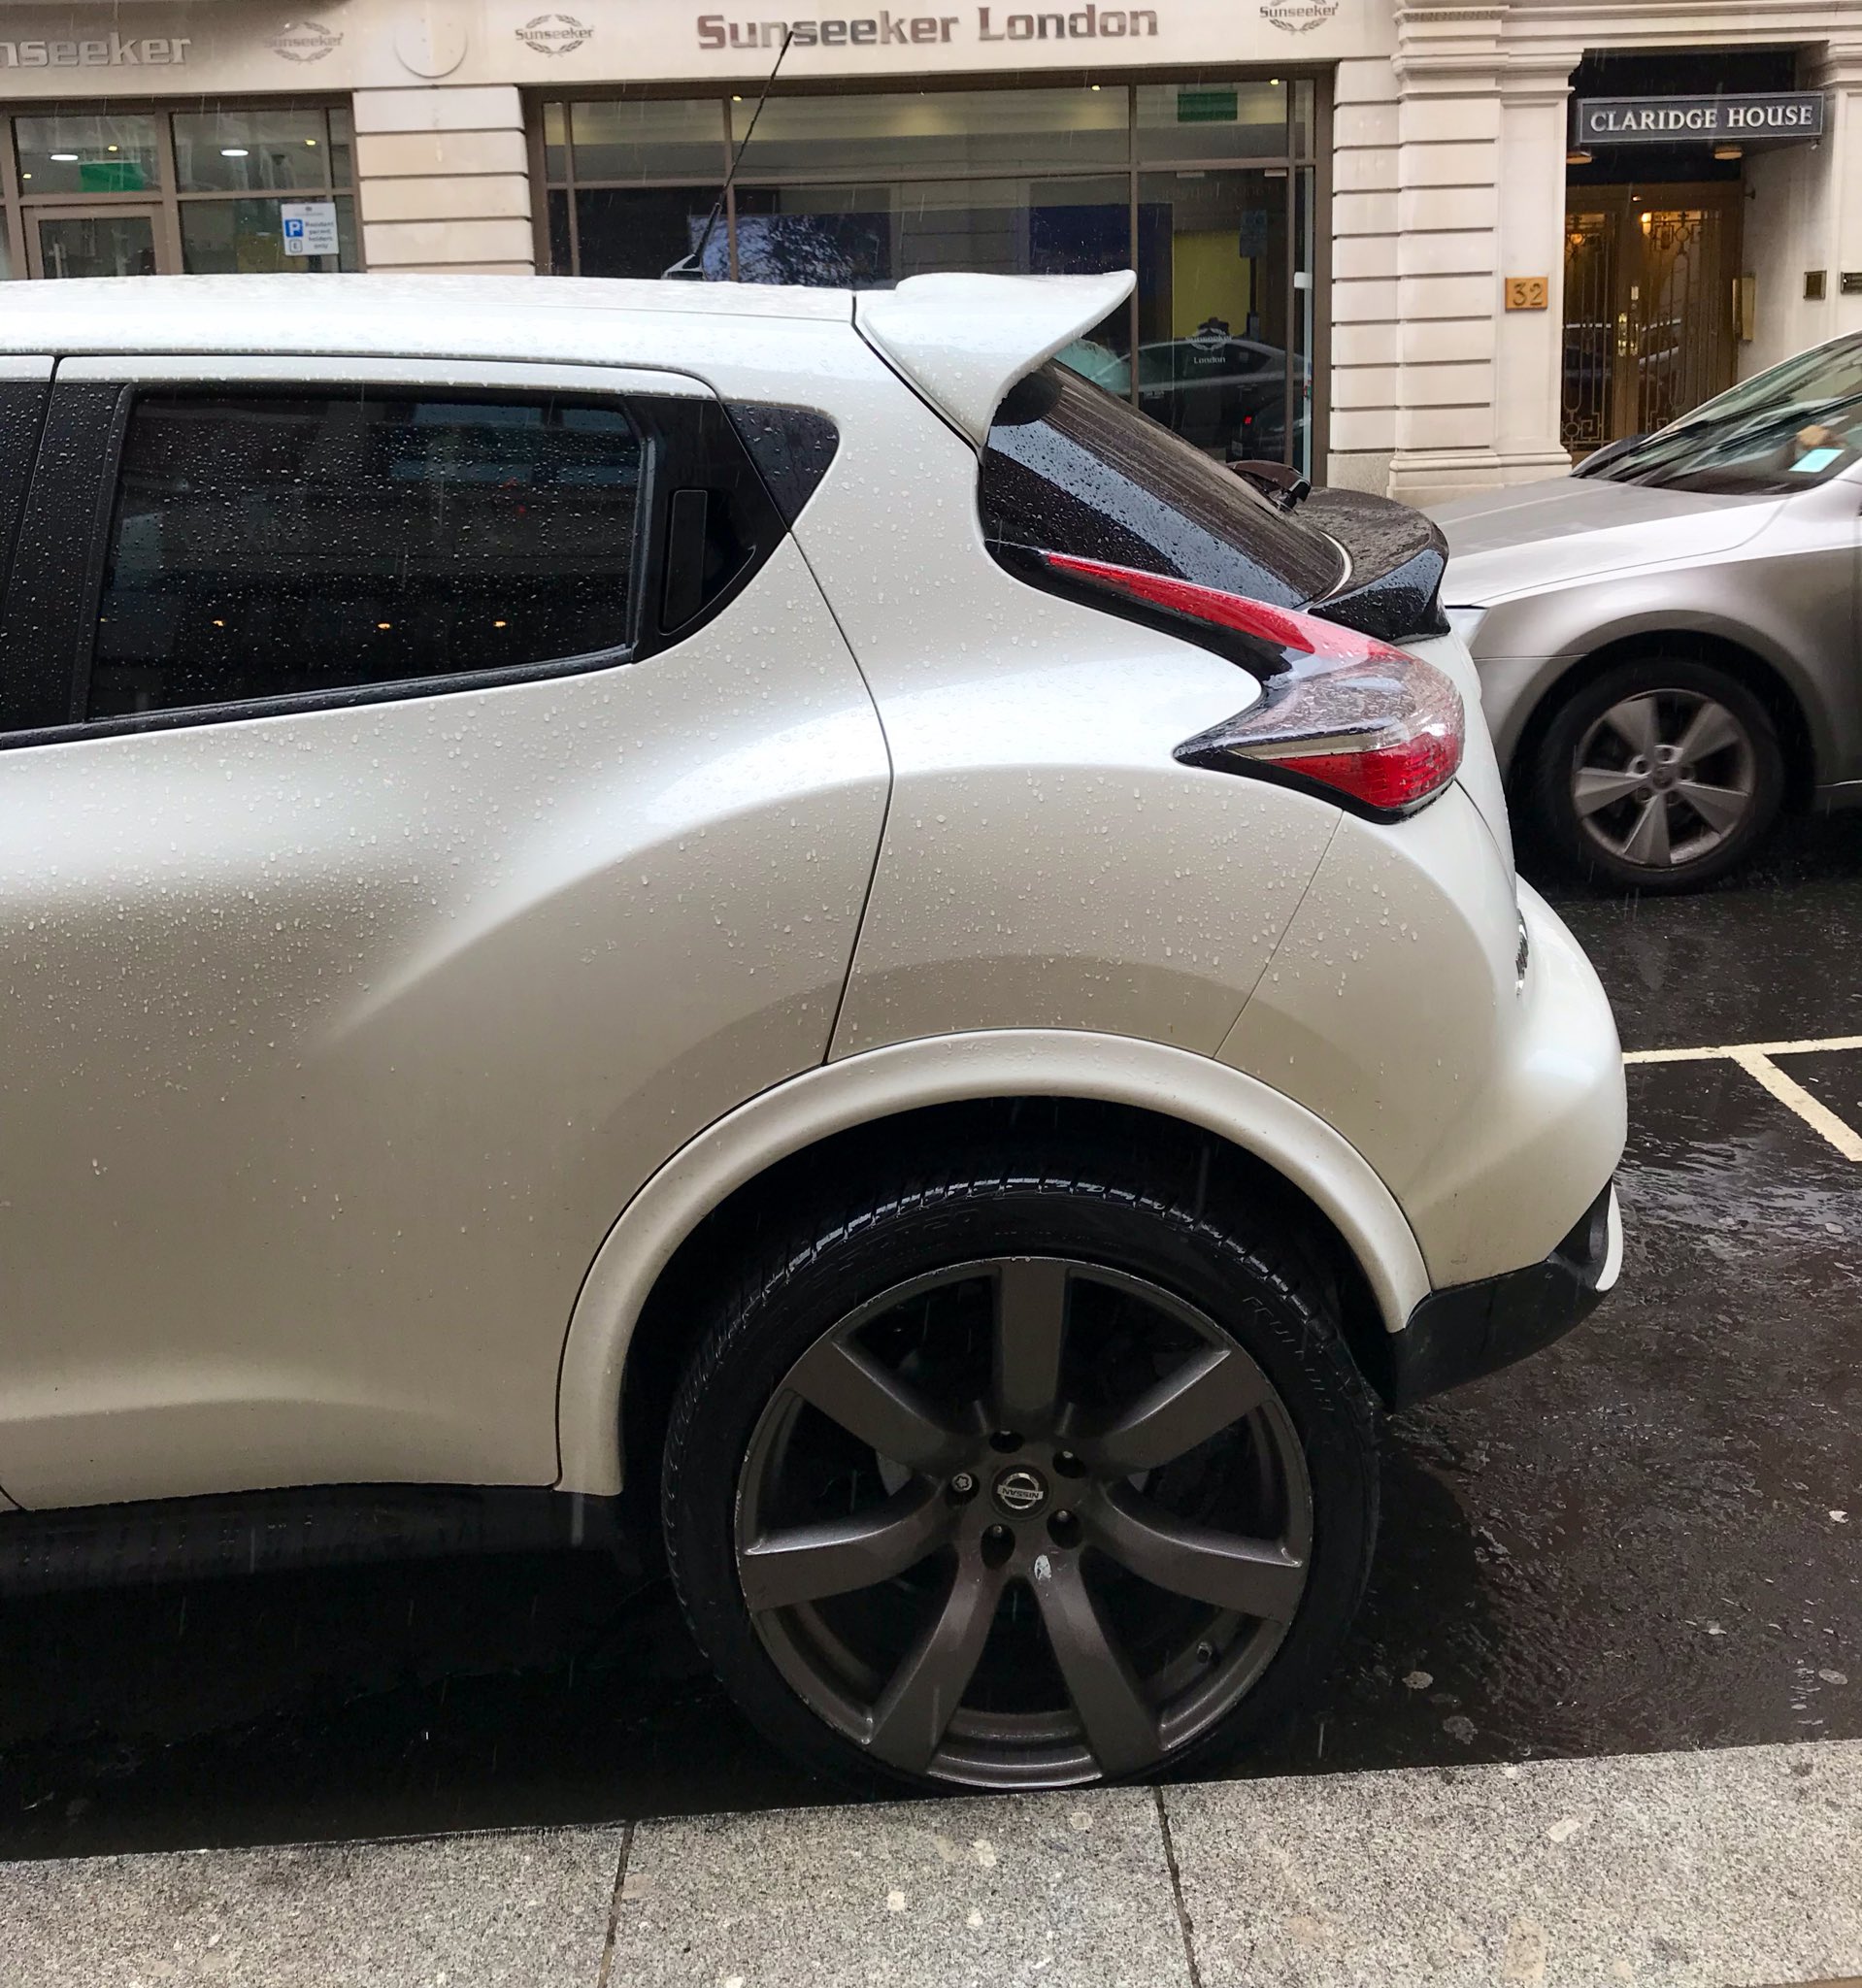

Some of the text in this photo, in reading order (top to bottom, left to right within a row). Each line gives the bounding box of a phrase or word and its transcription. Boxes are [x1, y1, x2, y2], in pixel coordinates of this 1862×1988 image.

[1259, 5, 1336, 17] Sunseeker
[515, 28, 594, 41] Sunseeker
[698, 4, 1159, 50] Sunseeker London
[1589, 105, 1813, 132] CLARIDGE HOUSE
[289, 221, 301, 236] P
[1513, 282, 1542, 306] 32
[1002, 1487, 1040, 1499] NISSAN
